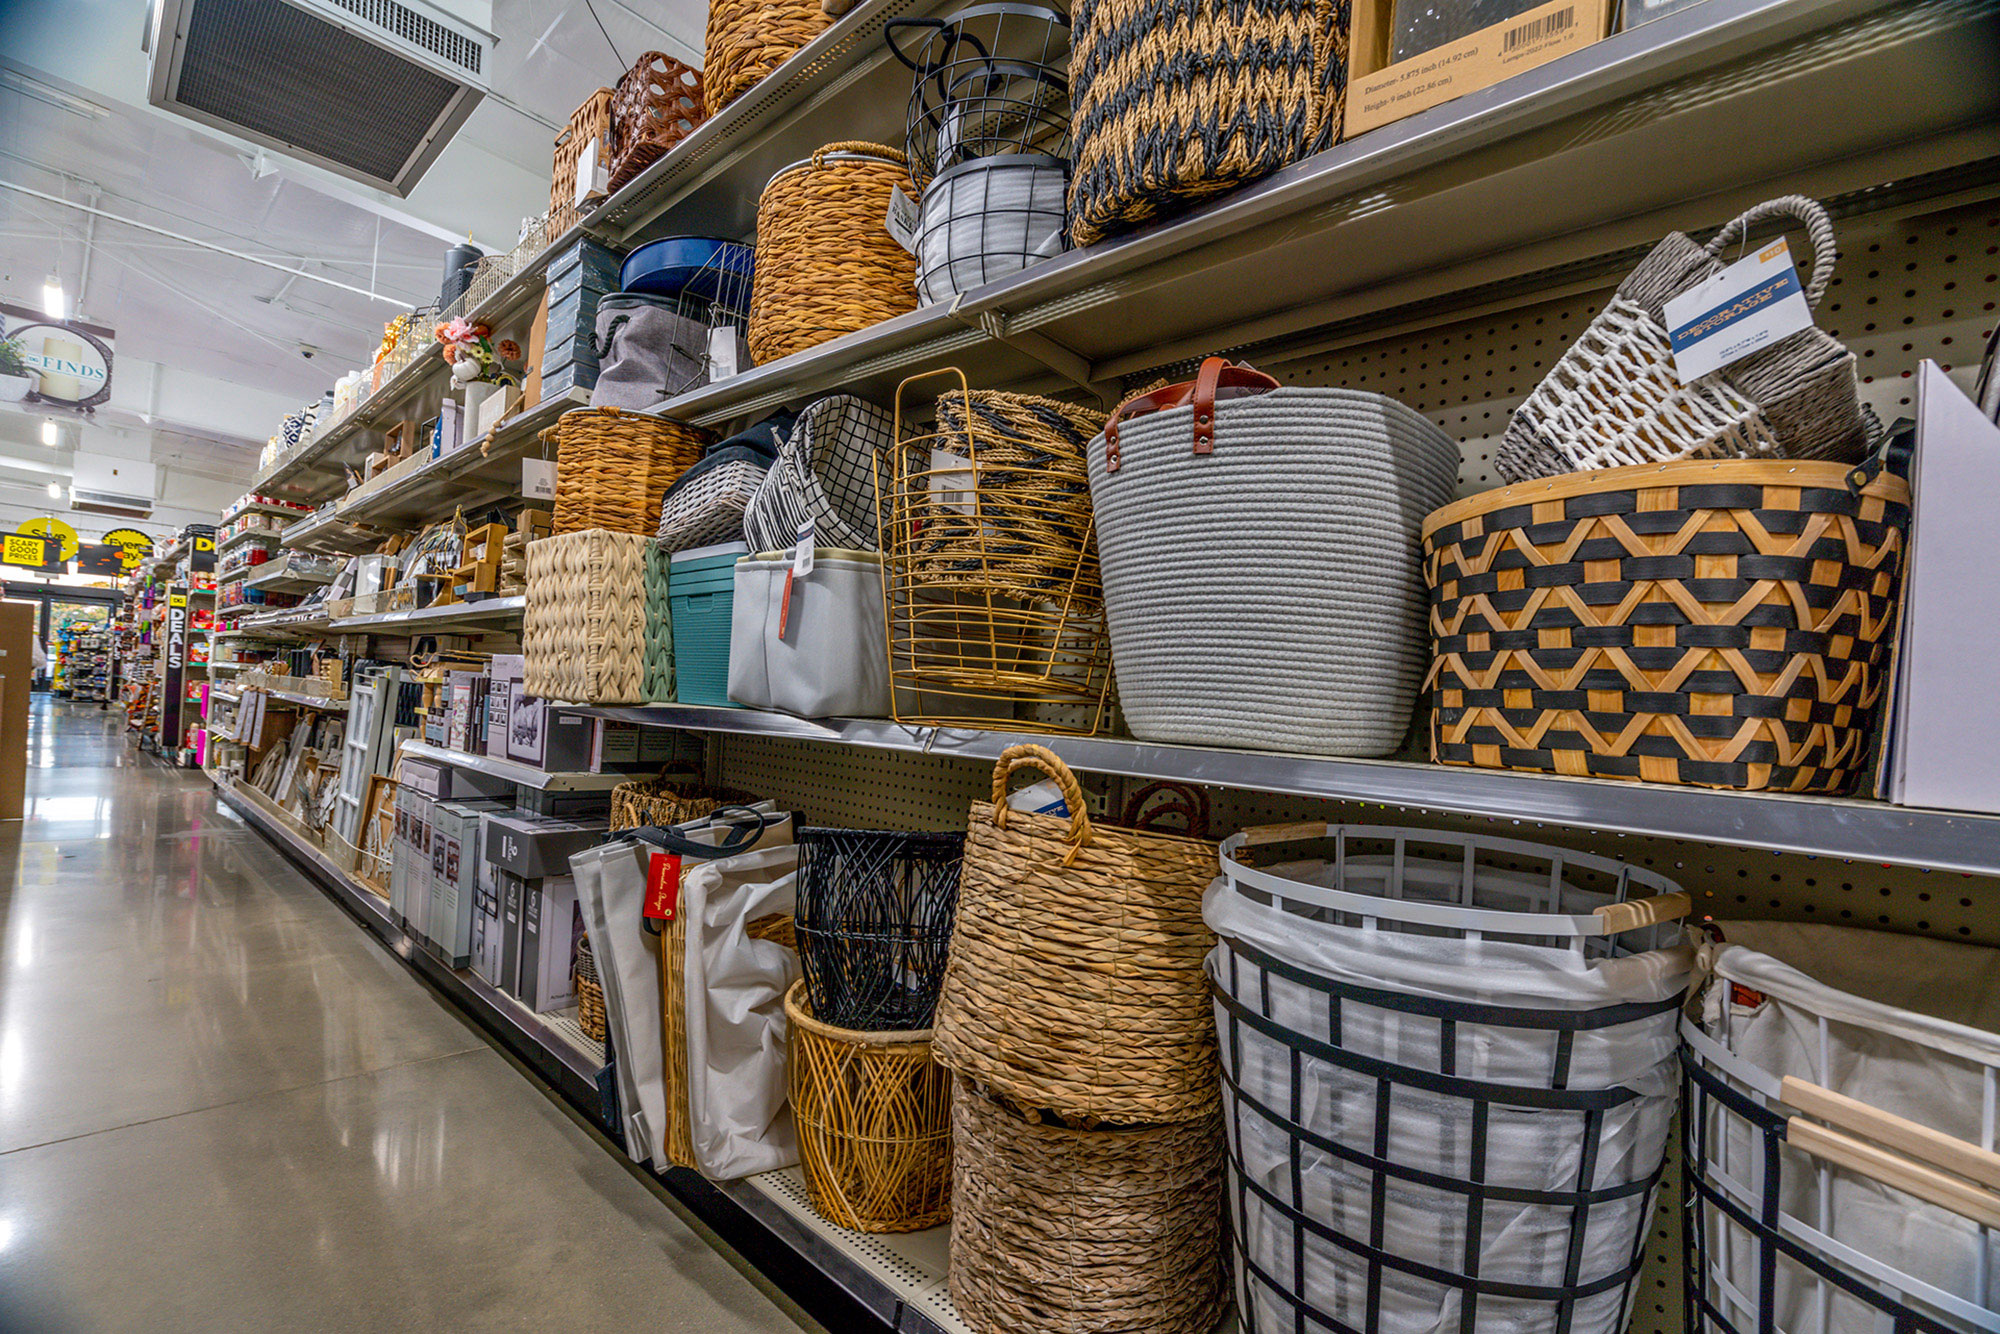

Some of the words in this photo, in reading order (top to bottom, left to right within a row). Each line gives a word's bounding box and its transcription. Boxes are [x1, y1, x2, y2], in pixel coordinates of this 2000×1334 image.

[1421, 62, 1437, 75] inch
[1438, 54, 1462, 69] (14.92
[1463, 46, 1479, 59] cm)
[1390, 95, 1396, 103] 9
[1396, 89, 1412, 101] inch
[1437, 75, 1453, 87] cm)
[1677, 278, 1789, 340] DECORATIVE
[1693, 292, 1774, 337] STORAGE
[43, 356, 105, 380] FINDS
[9, 538, 39, 547] SCARY
[9, 546, 38, 554] GOOD
[9, 552, 38, 561] PRICES
[168, 608, 185, 669] DEALS
